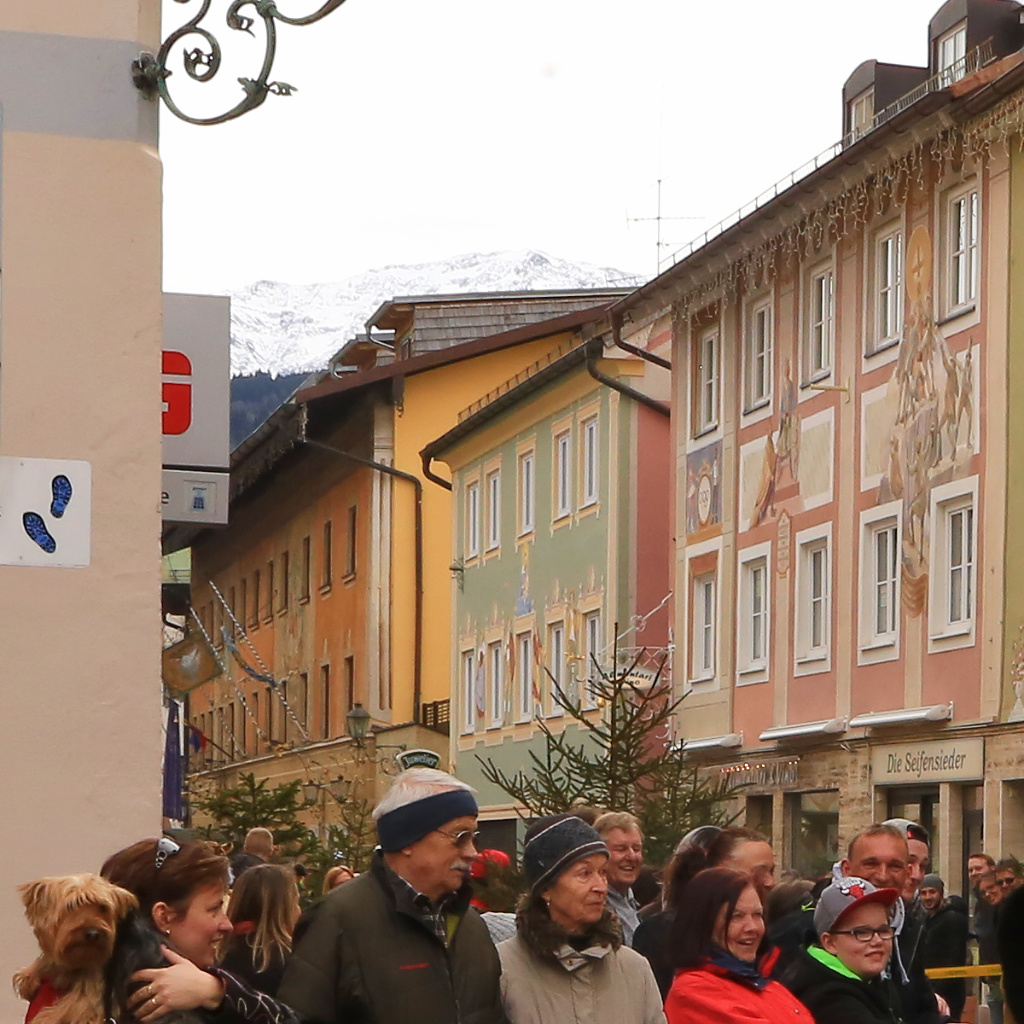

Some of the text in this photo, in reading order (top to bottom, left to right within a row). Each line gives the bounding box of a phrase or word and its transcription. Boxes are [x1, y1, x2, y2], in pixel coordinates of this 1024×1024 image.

[402, 753, 437, 768] Juwelier
[886, 747, 967, 778] Die Seifensieder
